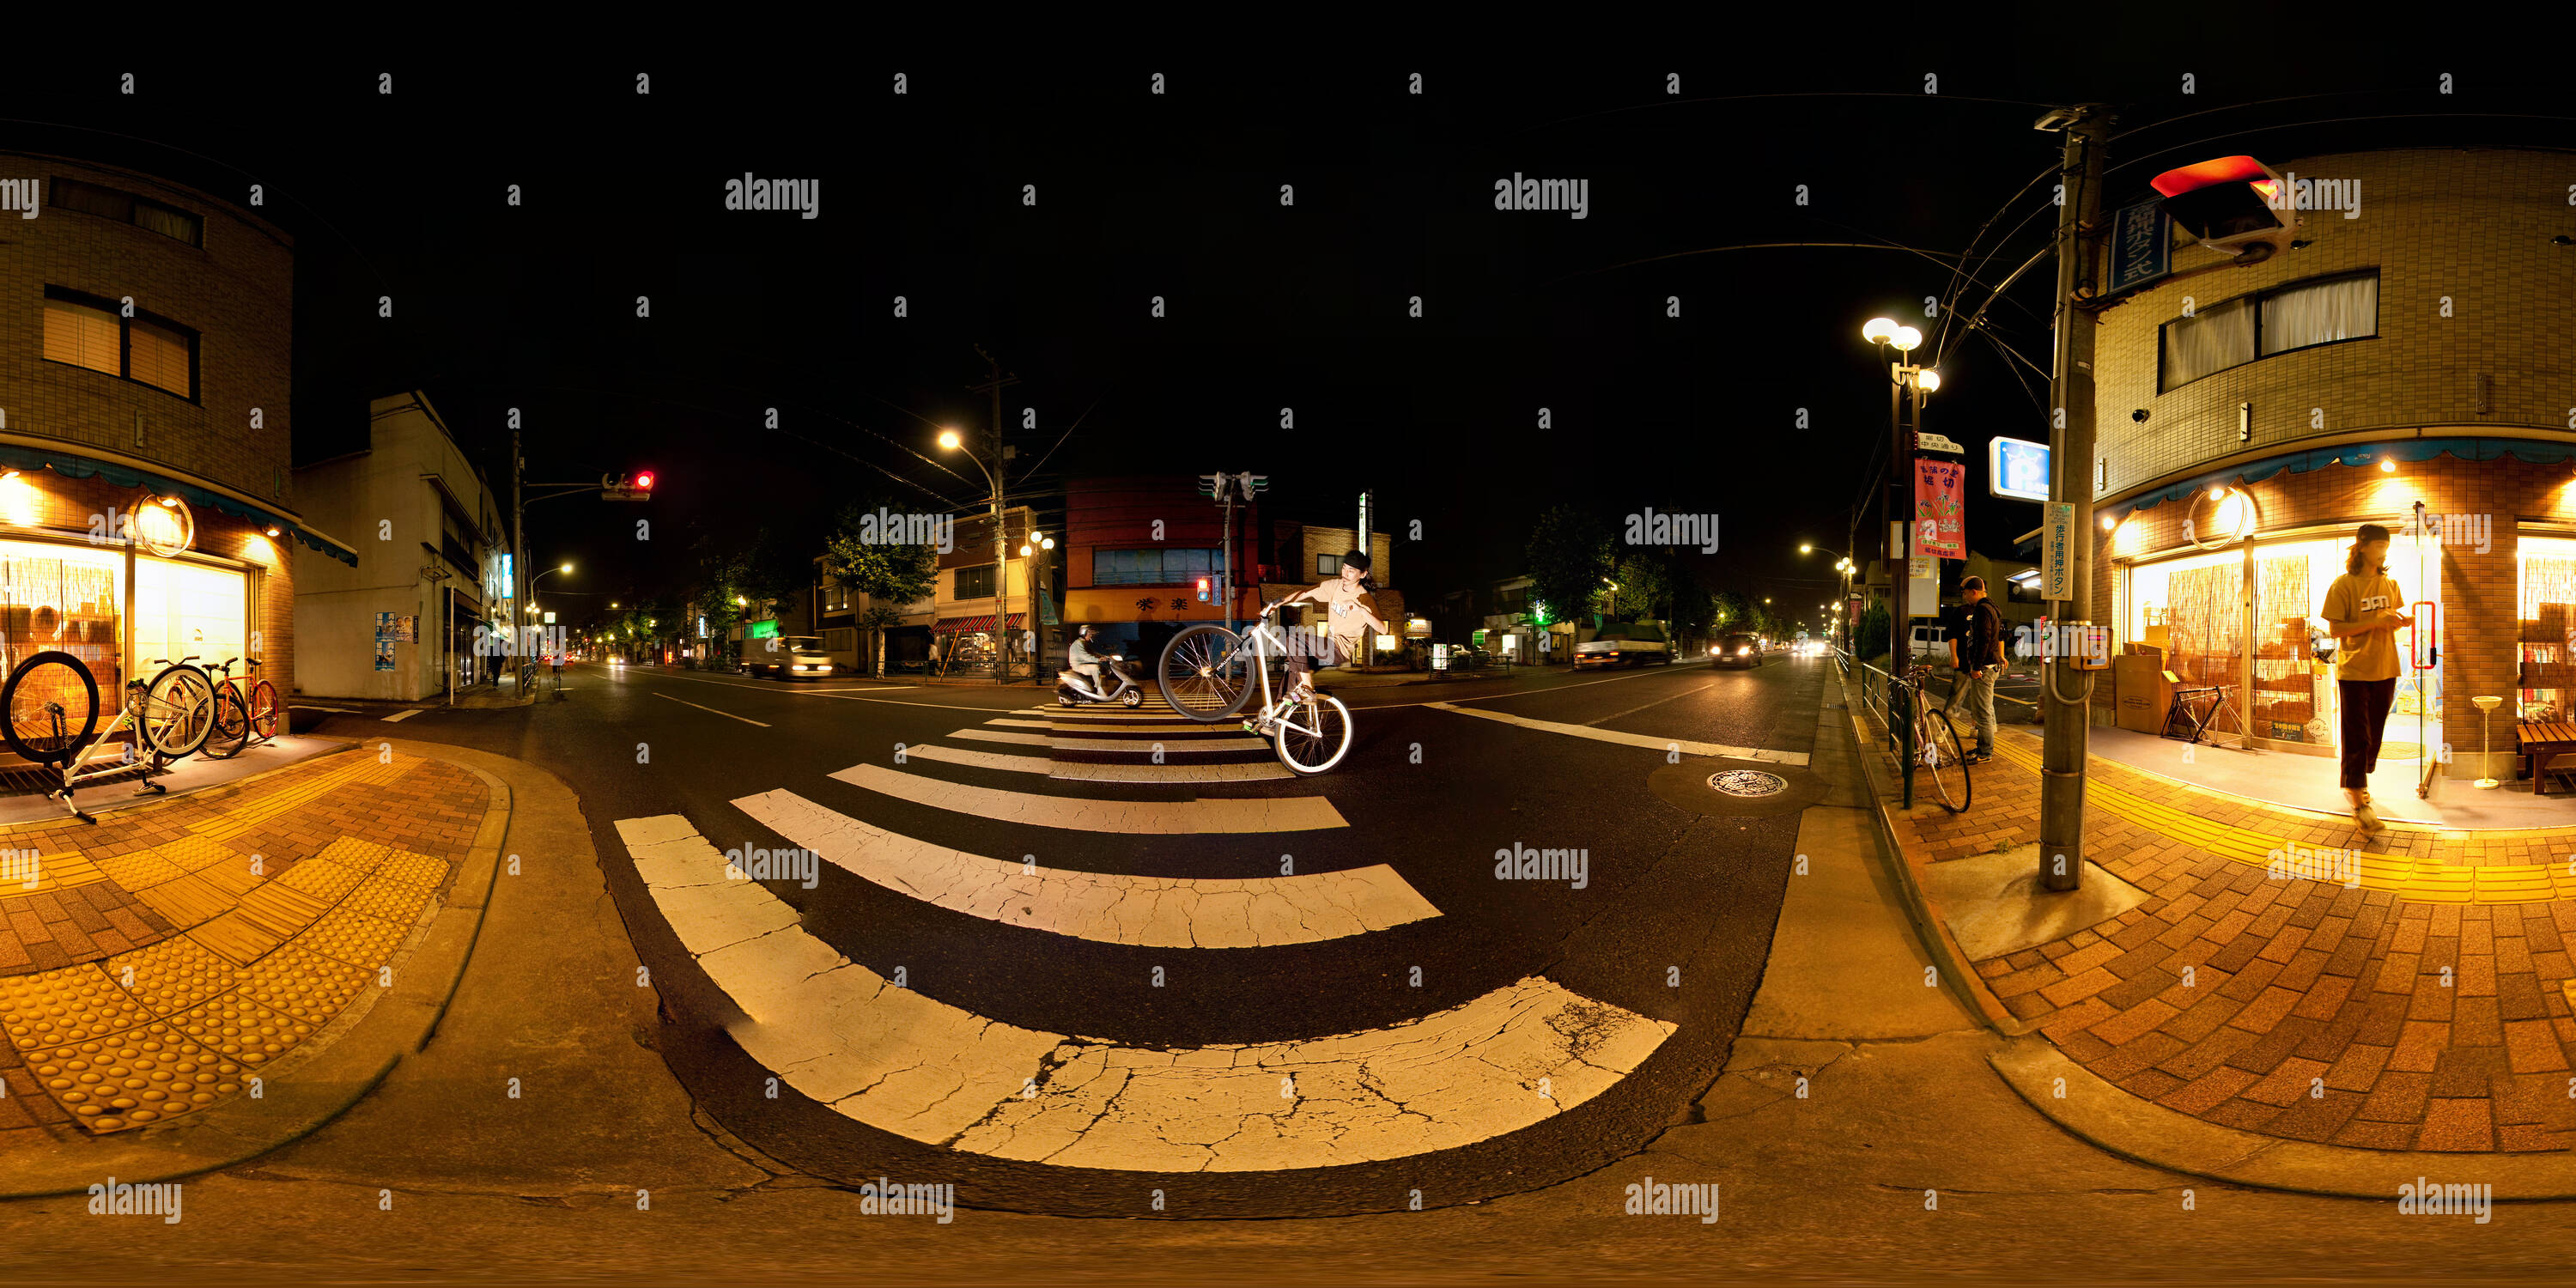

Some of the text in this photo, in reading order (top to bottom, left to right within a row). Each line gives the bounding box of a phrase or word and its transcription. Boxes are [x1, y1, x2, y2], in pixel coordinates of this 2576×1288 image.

[1923, 474, 1954, 489] 堀切
[2054, 525, 2066, 594] 歩行者用押ボタン
